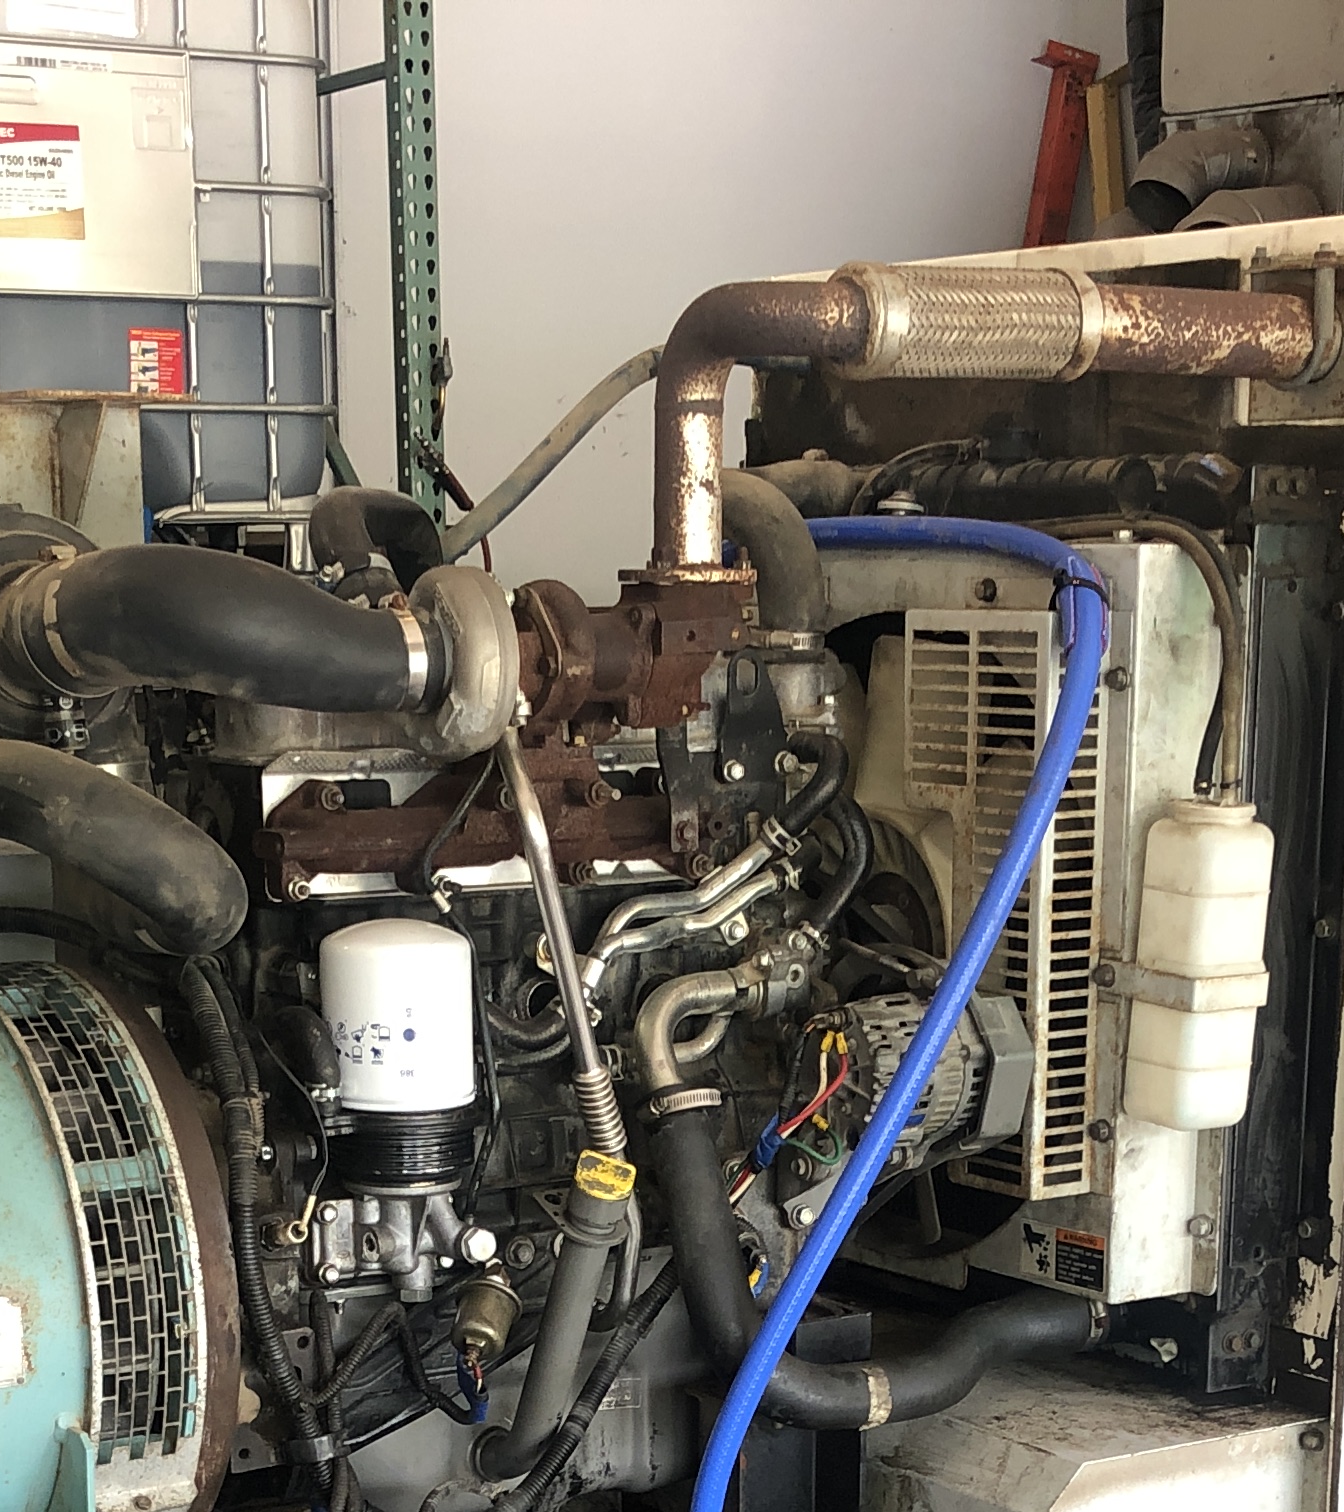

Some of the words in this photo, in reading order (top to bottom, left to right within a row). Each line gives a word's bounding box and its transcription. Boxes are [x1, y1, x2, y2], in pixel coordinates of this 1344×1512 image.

[0, 155, 24, 166] T500
[27, 156, 62, 167] 15W-40
[5, 169, 23, 178] Diesel
[25, 170, 45, 181] Engine
